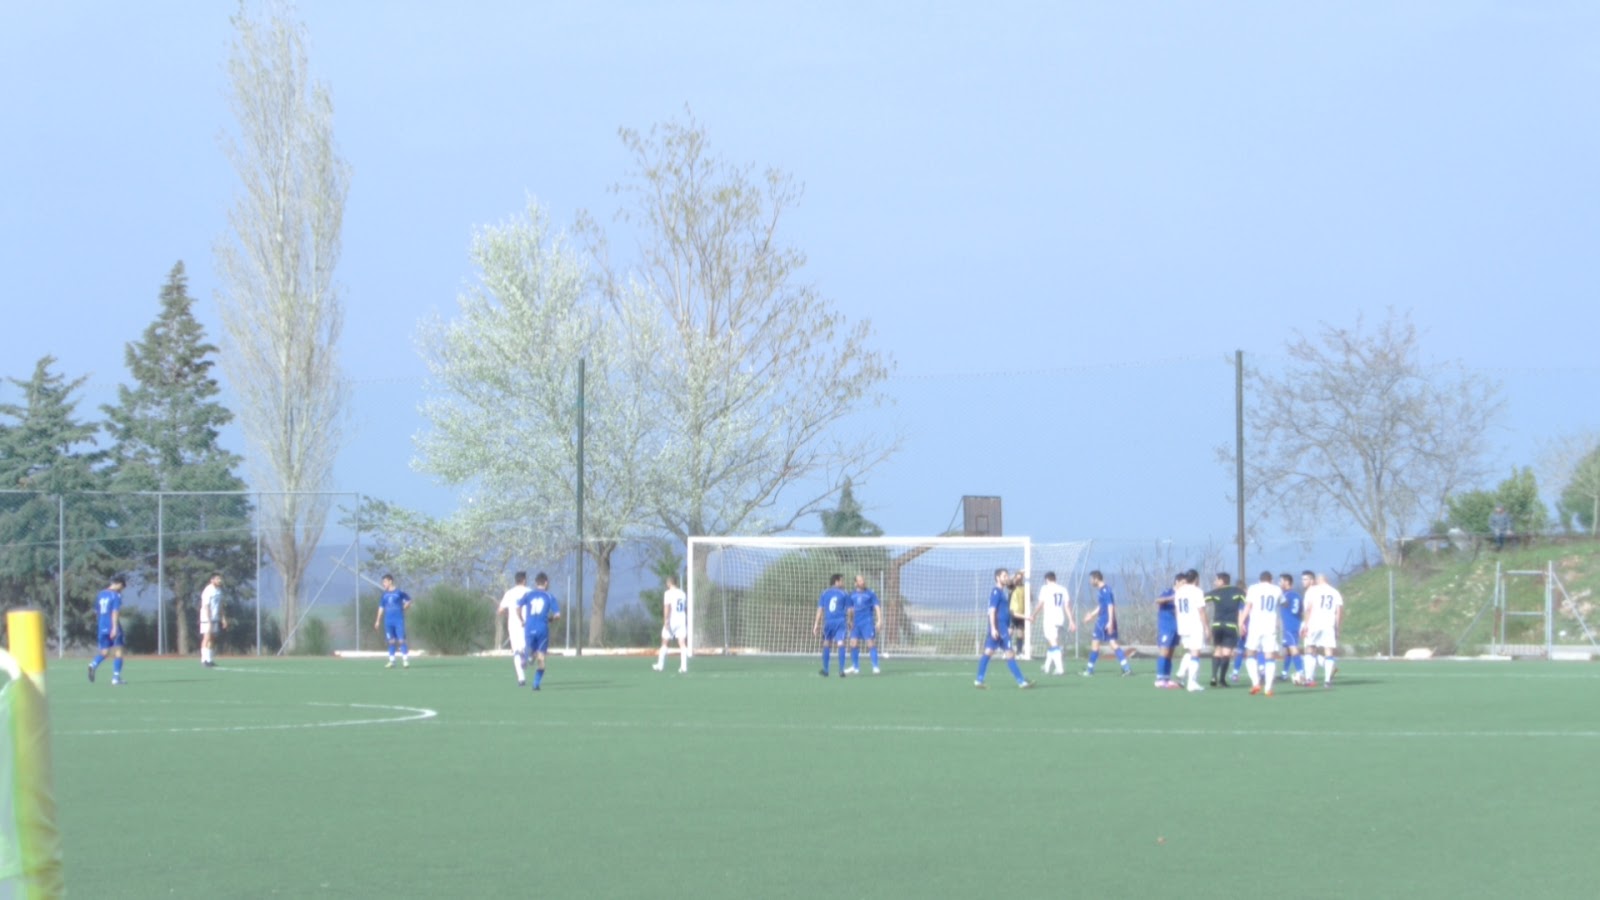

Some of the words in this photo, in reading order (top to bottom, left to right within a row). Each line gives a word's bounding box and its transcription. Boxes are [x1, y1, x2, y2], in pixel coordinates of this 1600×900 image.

[829, 596, 838, 612] 6
[1053, 593, 1063, 607] 17
[1178, 597, 1189, 614] 18
[1260, 594, 1275, 612] 10
[1291, 597, 1300, 614] 3
[1320, 594, 1334, 610] 13
